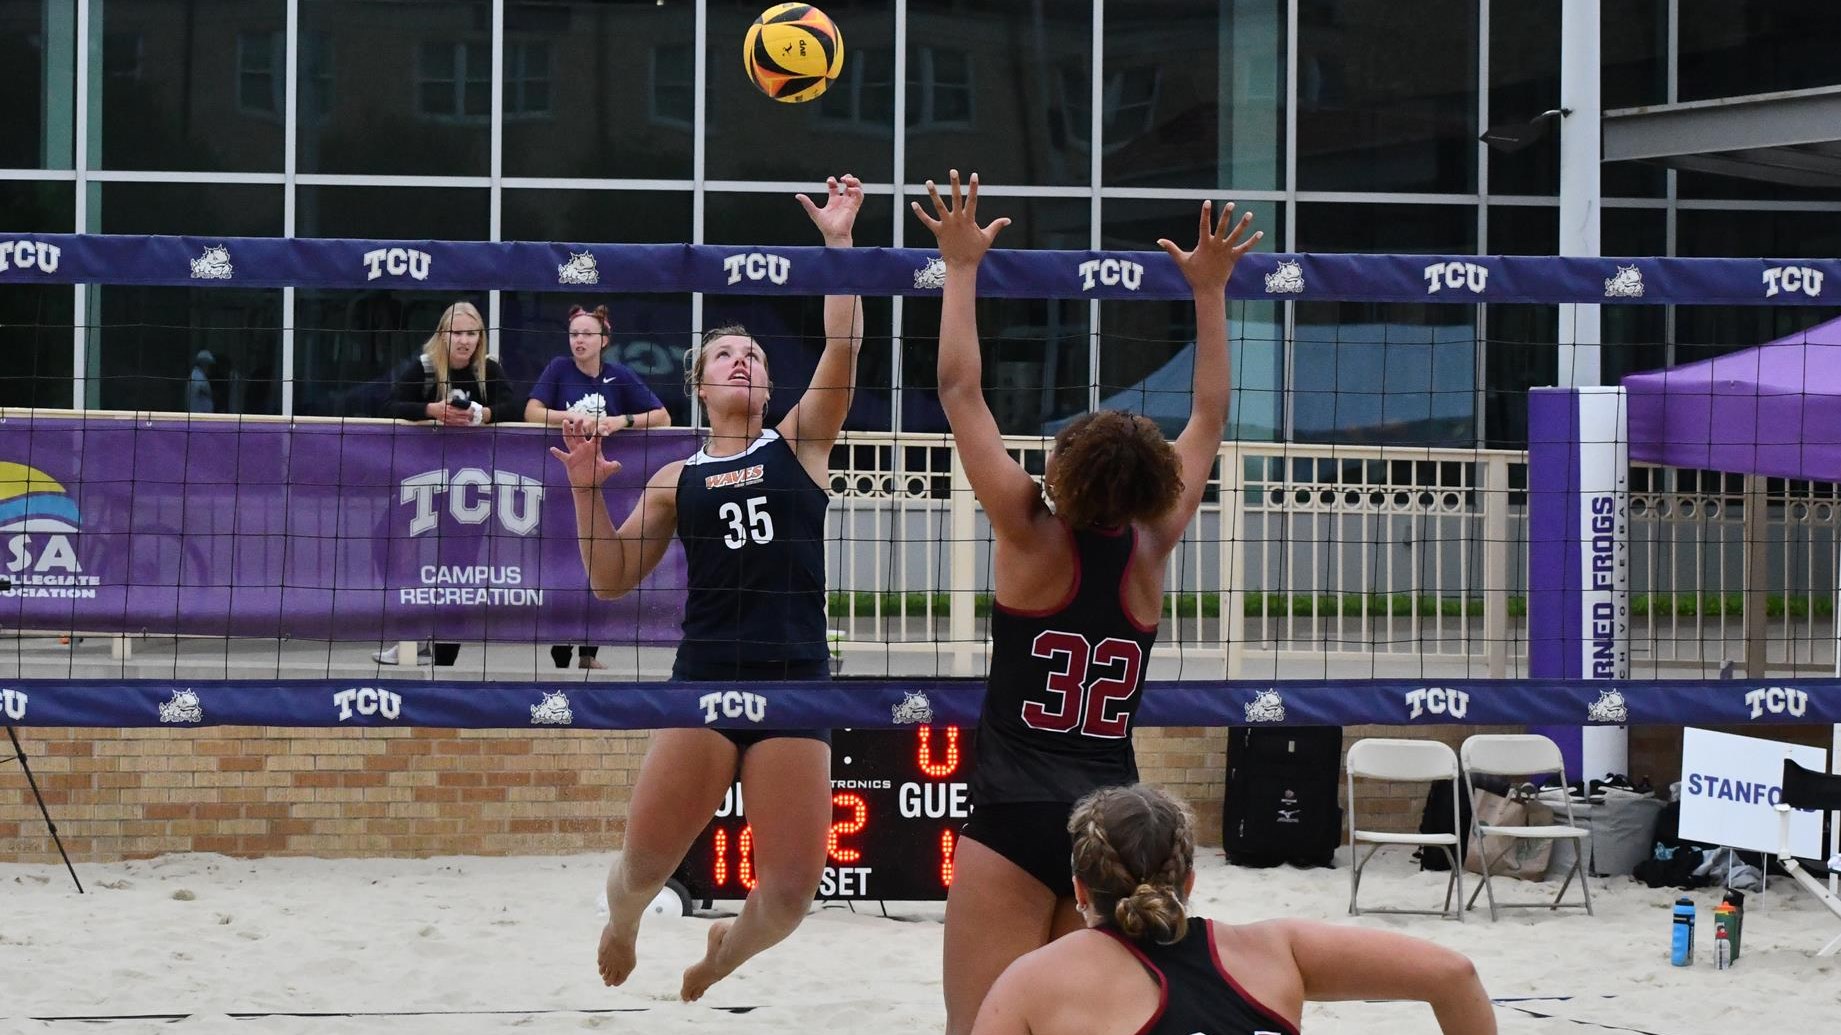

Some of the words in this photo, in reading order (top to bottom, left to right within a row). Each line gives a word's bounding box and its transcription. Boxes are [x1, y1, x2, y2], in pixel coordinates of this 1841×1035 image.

[0, 240, 61, 274] TCU
[364, 248, 432, 280] TCU
[723, 253, 791, 286] TCU
[1078, 259, 1144, 292] TCU
[1424, 262, 1488, 294] TCU
[1763, 266, 1824, 298] TCU
[705, 465, 764, 489] WAVES
[400, 467, 545, 537] TCU
[719, 496, 774, 550] 35
[1592, 497, 1614, 591] FROGS
[1618, 475, 1626, 633] VOLLEYBALL
[421, 565, 522, 584] CAMPUS
[0, 587, 96, 598] OCIATION
[400, 587, 544, 606] RECREATION
[1021, 629, 1143, 739] 32
[334, 688, 401, 721] TCU
[700, 690, 767, 724] TCU
[1406, 687, 1470, 720] TCU
[1745, 687, 1809, 719] TCU
[899, 782, 973, 818] GUE
[1688, 773, 1783, 808] STANFO
[827, 793, 867, 862] 2
[819, 867, 872, 896] SET
